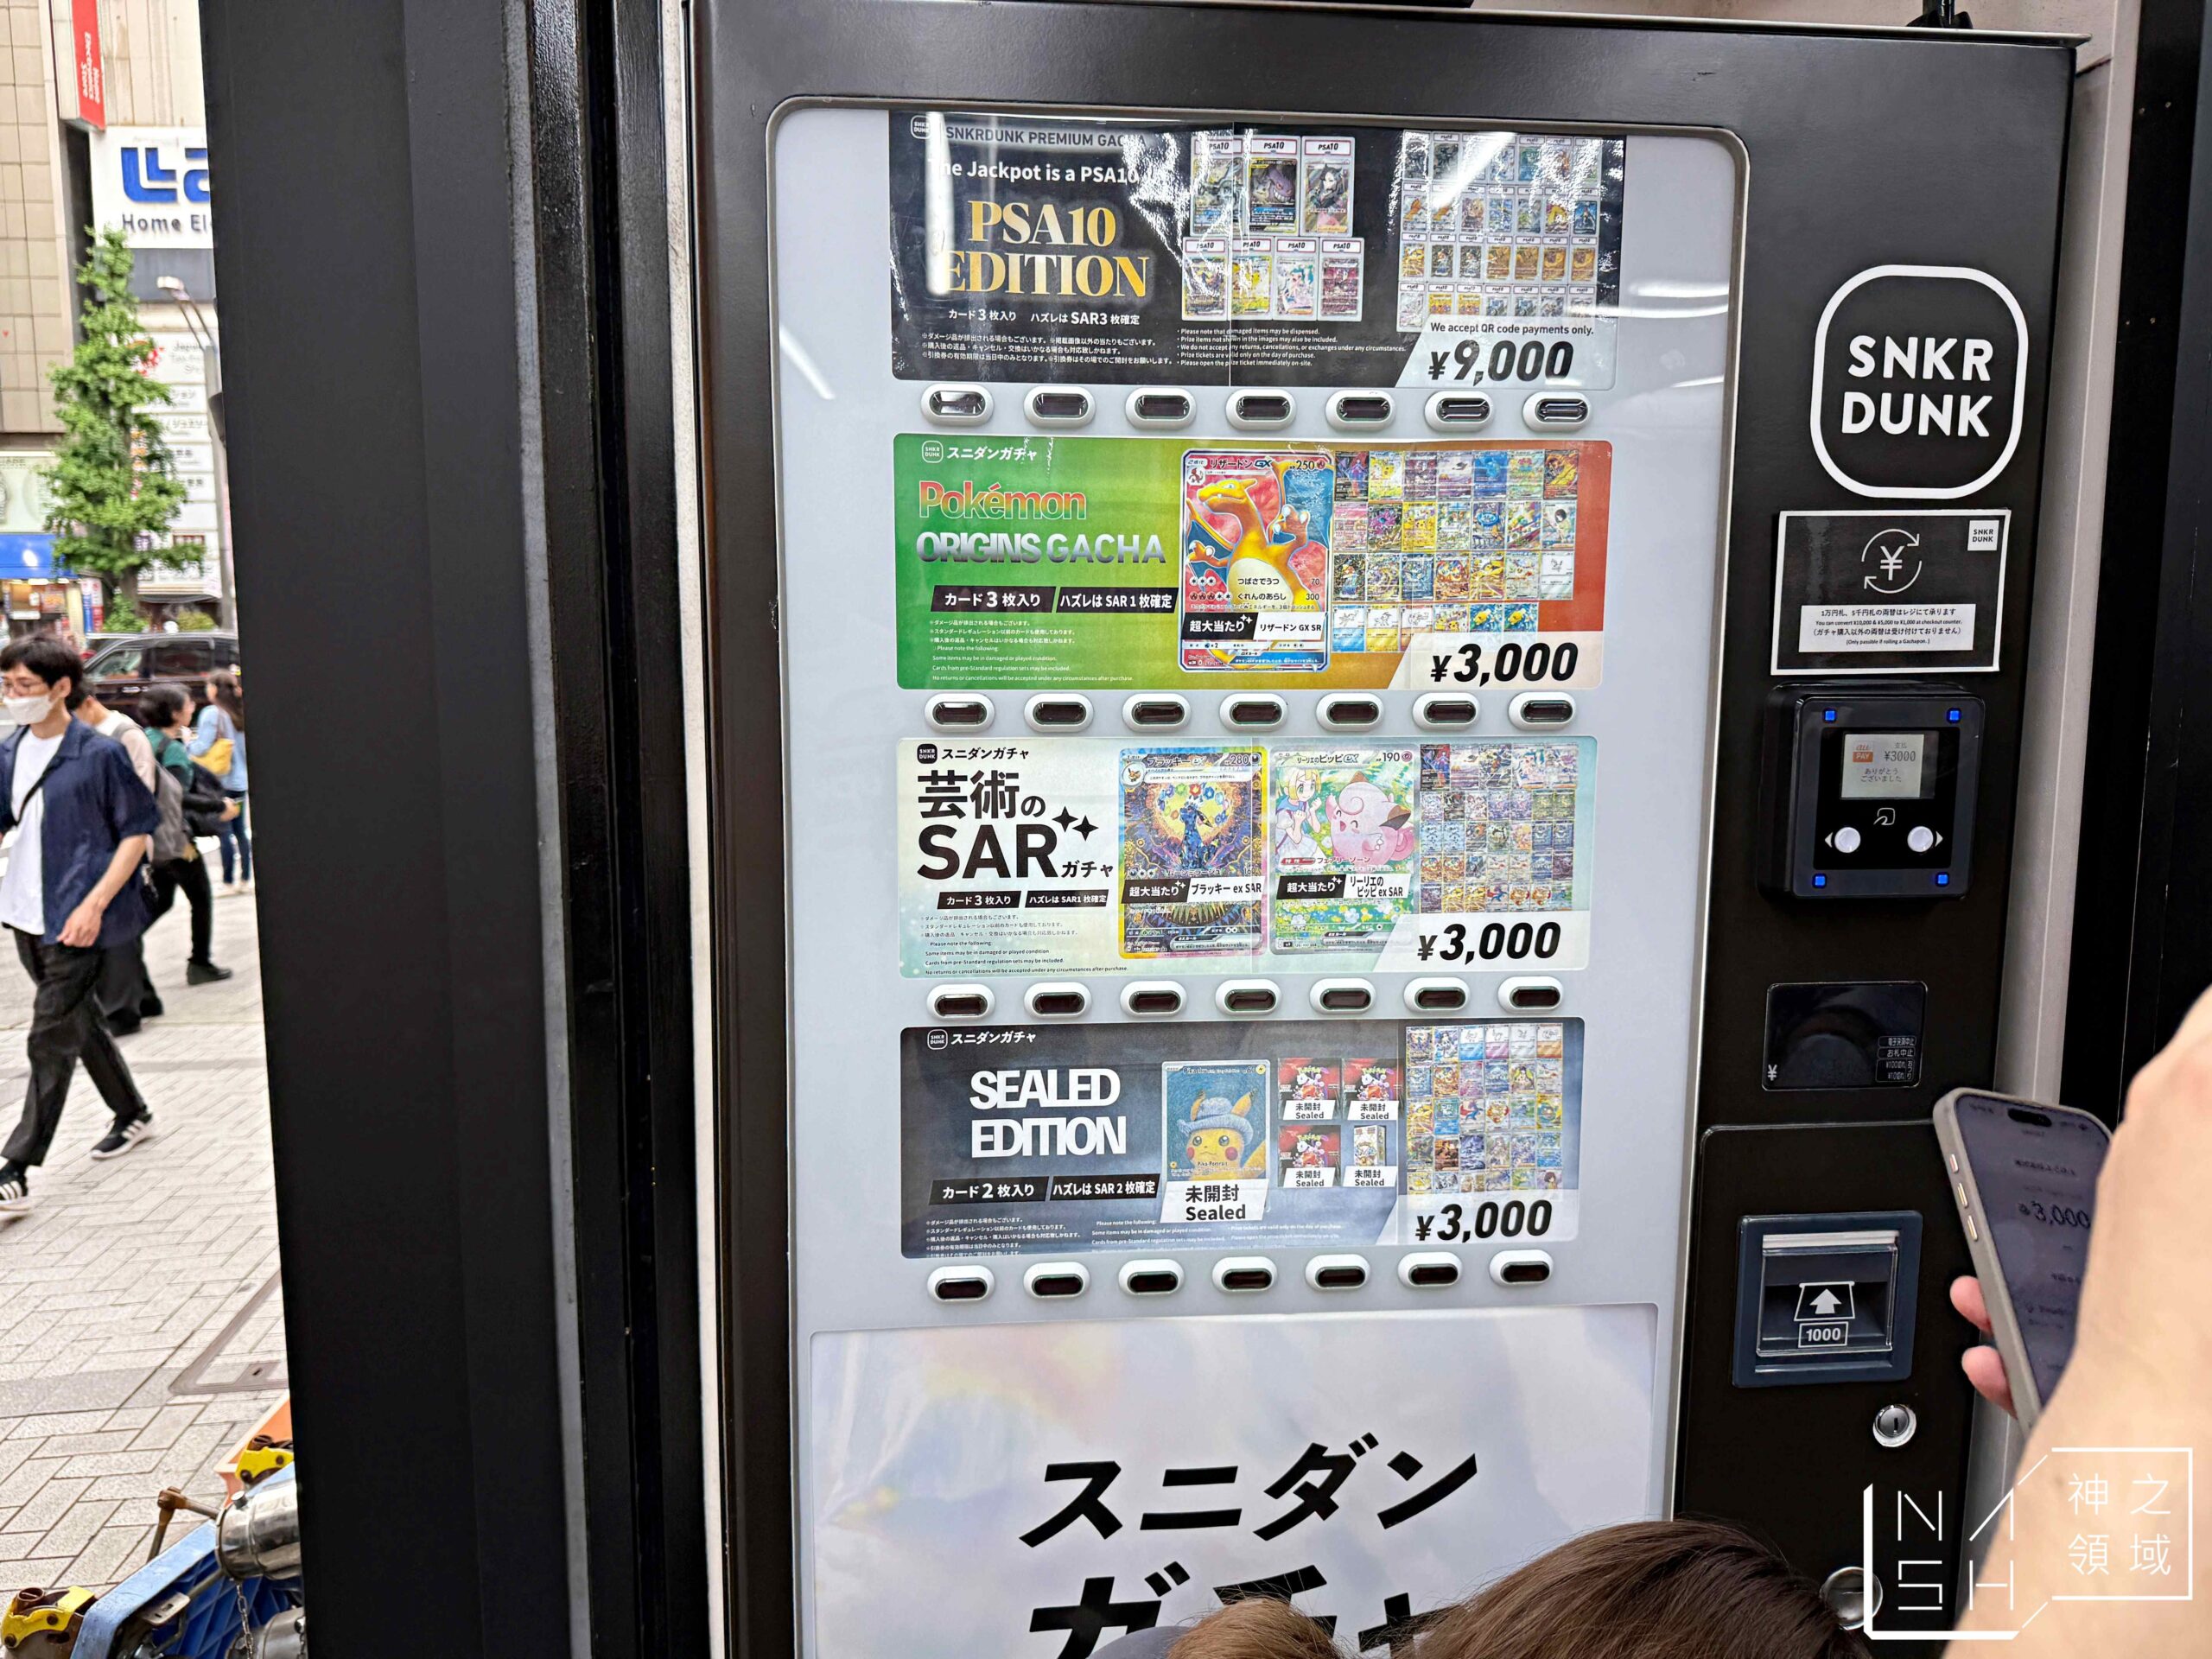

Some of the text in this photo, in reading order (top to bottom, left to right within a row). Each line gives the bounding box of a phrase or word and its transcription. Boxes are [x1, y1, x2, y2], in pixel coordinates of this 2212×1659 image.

[946, 126, 1025, 143] SNKRDUNK
[1028, 130, 1093, 147] PREMIUM
[1263, 141, 1285, 150] PSA10
[1317, 142, 1338, 151] PSA10
[966, 162, 1041, 182] Jackpot
[1046, 167, 1061, 181] is
[1065, 169, 1075, 181] a
[122, 214, 181, 233] Home
[968, 200, 1116, 247] PSA10
[946, 251, 1149, 297] EDITION
[1430, 322, 1594, 336] We accept QR code payments only.
[1427, 339, 1574, 387] ¥9,000
[1848, 334, 1993, 381] SNKR
[1841, 391, 1993, 437] DUNK
[947, 446, 1037, 461] スニダンガチャ
[1211, 459, 1253, 468] リザードン
[1296, 460, 1314, 470] 250
[918, 480, 1087, 520] Pokémon
[916, 531, 1166, 563] ORIGINS GACHA
[1189, 620, 1245, 632] 超大当たり
[1430, 642, 1579, 688] ¥3,000
[941, 747, 1030, 760] スニダンガチャ
[1382, 752, 1401, 762] 190
[1884, 750, 1916, 762] ¥3000
[918, 770, 1046, 819] 芸術の
[917, 823, 1114, 880] SAR ガチャ
[1287, 882, 1336, 893] 超大当たり
[1350, 876, 1384, 887] リーリエの
[1129, 882, 1262, 897] 超大当たり ブラッキー ex SAR
[1378, 888, 1387, 897] ex
[1389, 887, 1403, 897] SAR
[1417, 921, 1561, 965] ¥3,000
[950, 1031, 1036, 1046] スニダンガチャ
[969, 1068, 1121, 1109] SEALED
[1295, 1103, 1321, 1111] 未開封
[1360, 1103, 1386, 1112] 未開封
[971, 1116, 1127, 1158] EDITION
[1295, 1170, 1321, 1179] 未開封
[1354, 1169, 1382, 1179] 未開封
[1295, 1179, 1325, 1187] Sealed
[1354, 1178, 1385, 1186] Sealed
[1185, 1184, 1240, 1203] 未開封
[1185, 1204, 1246, 1221] Sealed
[1415, 1199, 1553, 1243] ¥3,000
[1806, 1327, 1841, 1342] 1000
[1019, 1432, 1478, 1548] スニダン
